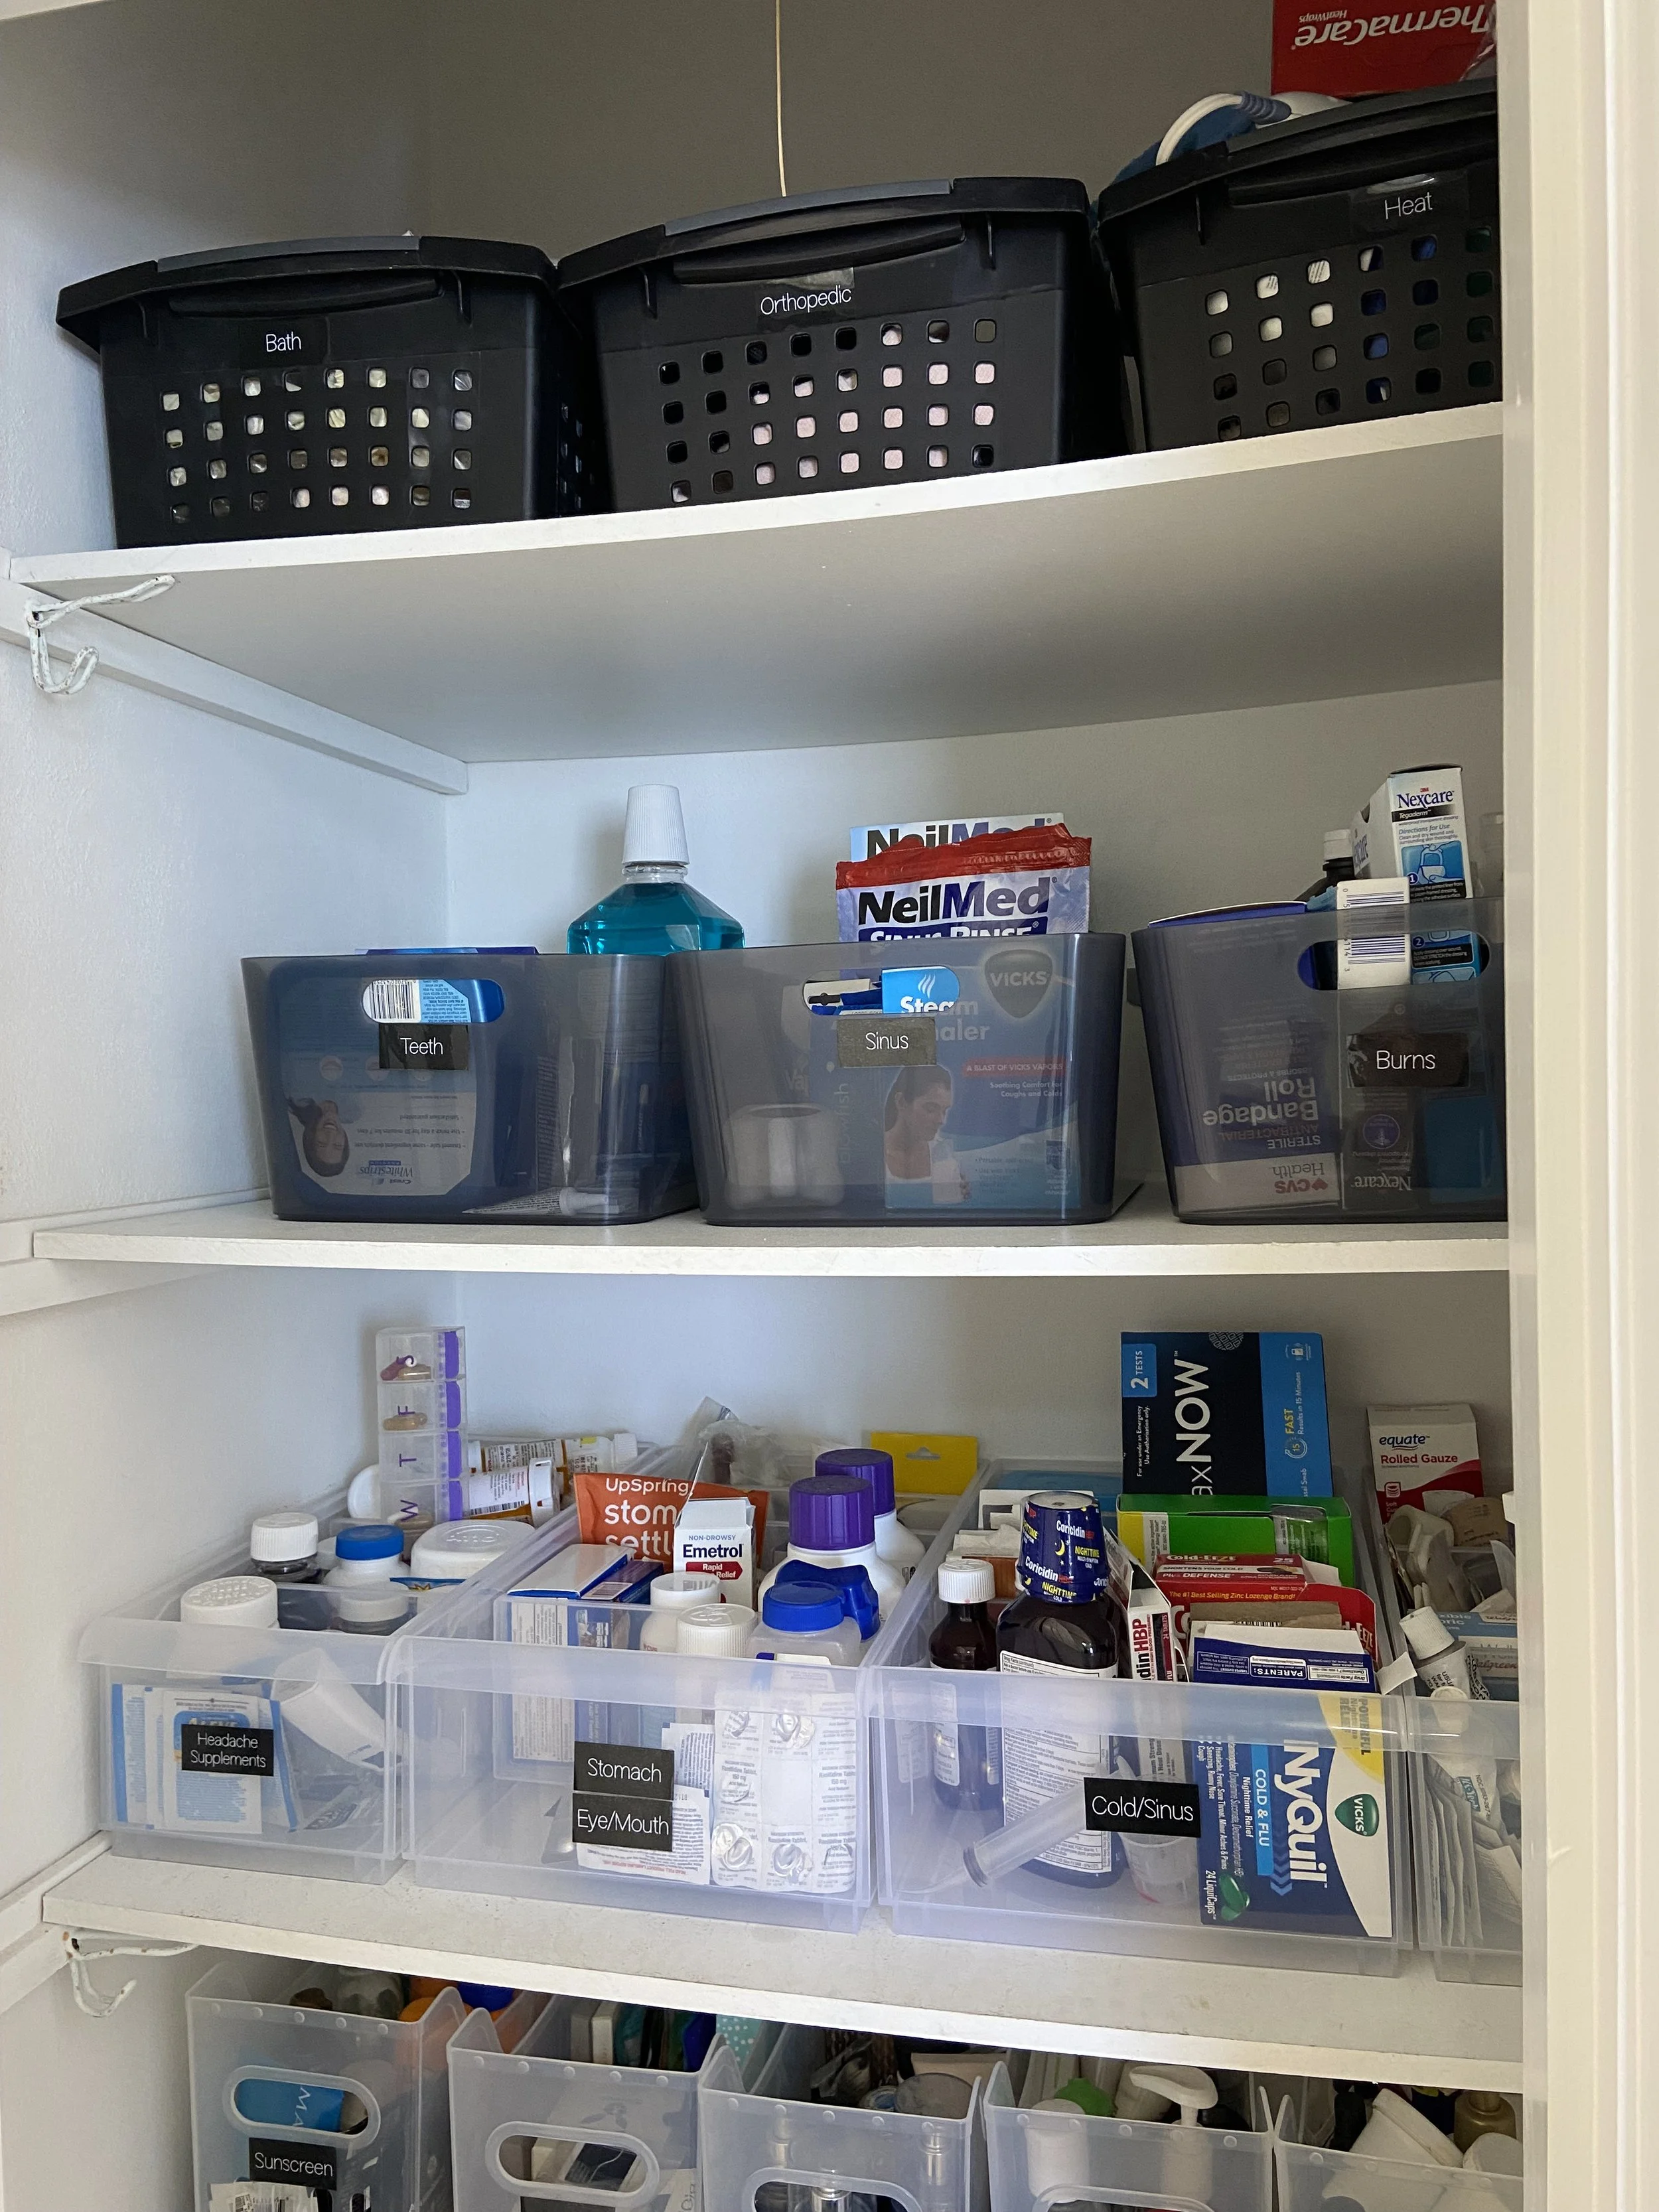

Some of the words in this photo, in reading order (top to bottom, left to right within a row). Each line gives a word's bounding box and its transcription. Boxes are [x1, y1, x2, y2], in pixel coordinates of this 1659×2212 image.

[1299, 9, 1347, 23] HeatWraps
[1384, 192, 1433, 220] Heat
[760, 285, 852, 316] Orthopedic
[265, 331, 302, 352] Bath
[1397, 790, 1453, 808] Nexcare
[1399, 826, 1427, 835] Directions
[858, 877, 1050, 926] NeilMed
[990, 971, 1047, 988] VICKS
[900, 996, 978, 1016] Steam
[399, 1037, 443, 1056] Teeth
[865, 1031, 909, 1051] Sinus
[1376, 1049, 1435, 1070] Burns
[1265, 1076, 1317, 1102] Roll
[1202, 1101, 1319, 1126] Bandage
[1267, 1135, 1322, 1149] STERILE
[359, 1167, 413, 1178] Whitestrips
[1273, 1162, 1324, 1177] Health
[1273, 1179, 1311, 1194] CVS
[1354, 1172, 1412, 1191] Nexcare
[1131, 1377, 1149, 1389] 2
[397, 1405, 415, 1416] F
[1283, 1408, 1294, 1434] FAST
[1379, 1434, 1426, 1448] equate
[399, 1453, 417, 1467] T
[1381, 1454, 1417, 1464] Rolled
[1421, 1454, 1458, 1463] Gauze
[605, 1478, 690, 1496] UpSpring
[400, 1499, 419, 1522] W
[683, 1544, 743, 1558] Emetrol
[1075, 1546, 1100, 1558] NIGHTTIME
[703, 1563, 723, 1572] Rapid
[1254, 1668, 1303, 1676] PARENTS:
[1360, 1698, 1371, 1755] POWERFUL
[197, 1732, 258, 1749] Headache
[190, 1749, 265, 1768] Supplements
[1197, 1745, 1206, 1761] Cough
[1206, 1746, 1215, 1769] Sneezing,
[1215, 1747, 1225, 1773] Headache,
[587, 1757, 663, 1783] Stomach
[1216, 1773, 1226, 1787] Fever,
[1255, 1769, 1267, 1805] COLD
[1217, 1789, 1226, 1801] Sore
[1242, 1777, 1252, 1814] Nighttime
[1091, 1795, 1194, 1822] Cold/Sinus
[1218, 1801, 1226, 1818] Throat,
[1258, 1808, 1268, 1820] &
[1274, 1739, 1327, 1883] NyQuil
[1353, 1797, 1365, 1832] VICKS
[577, 1809, 670, 1836] Eye/Mouth
[1244, 1816, 1253, 1838] Relief
[1258, 1822, 1270, 1846] FLU
[1205, 1870, 1216, 1879] 24
[1205, 1880, 1218, 1915] LiquiCaps
[254, 2152, 333, 2177] Sunscreen
